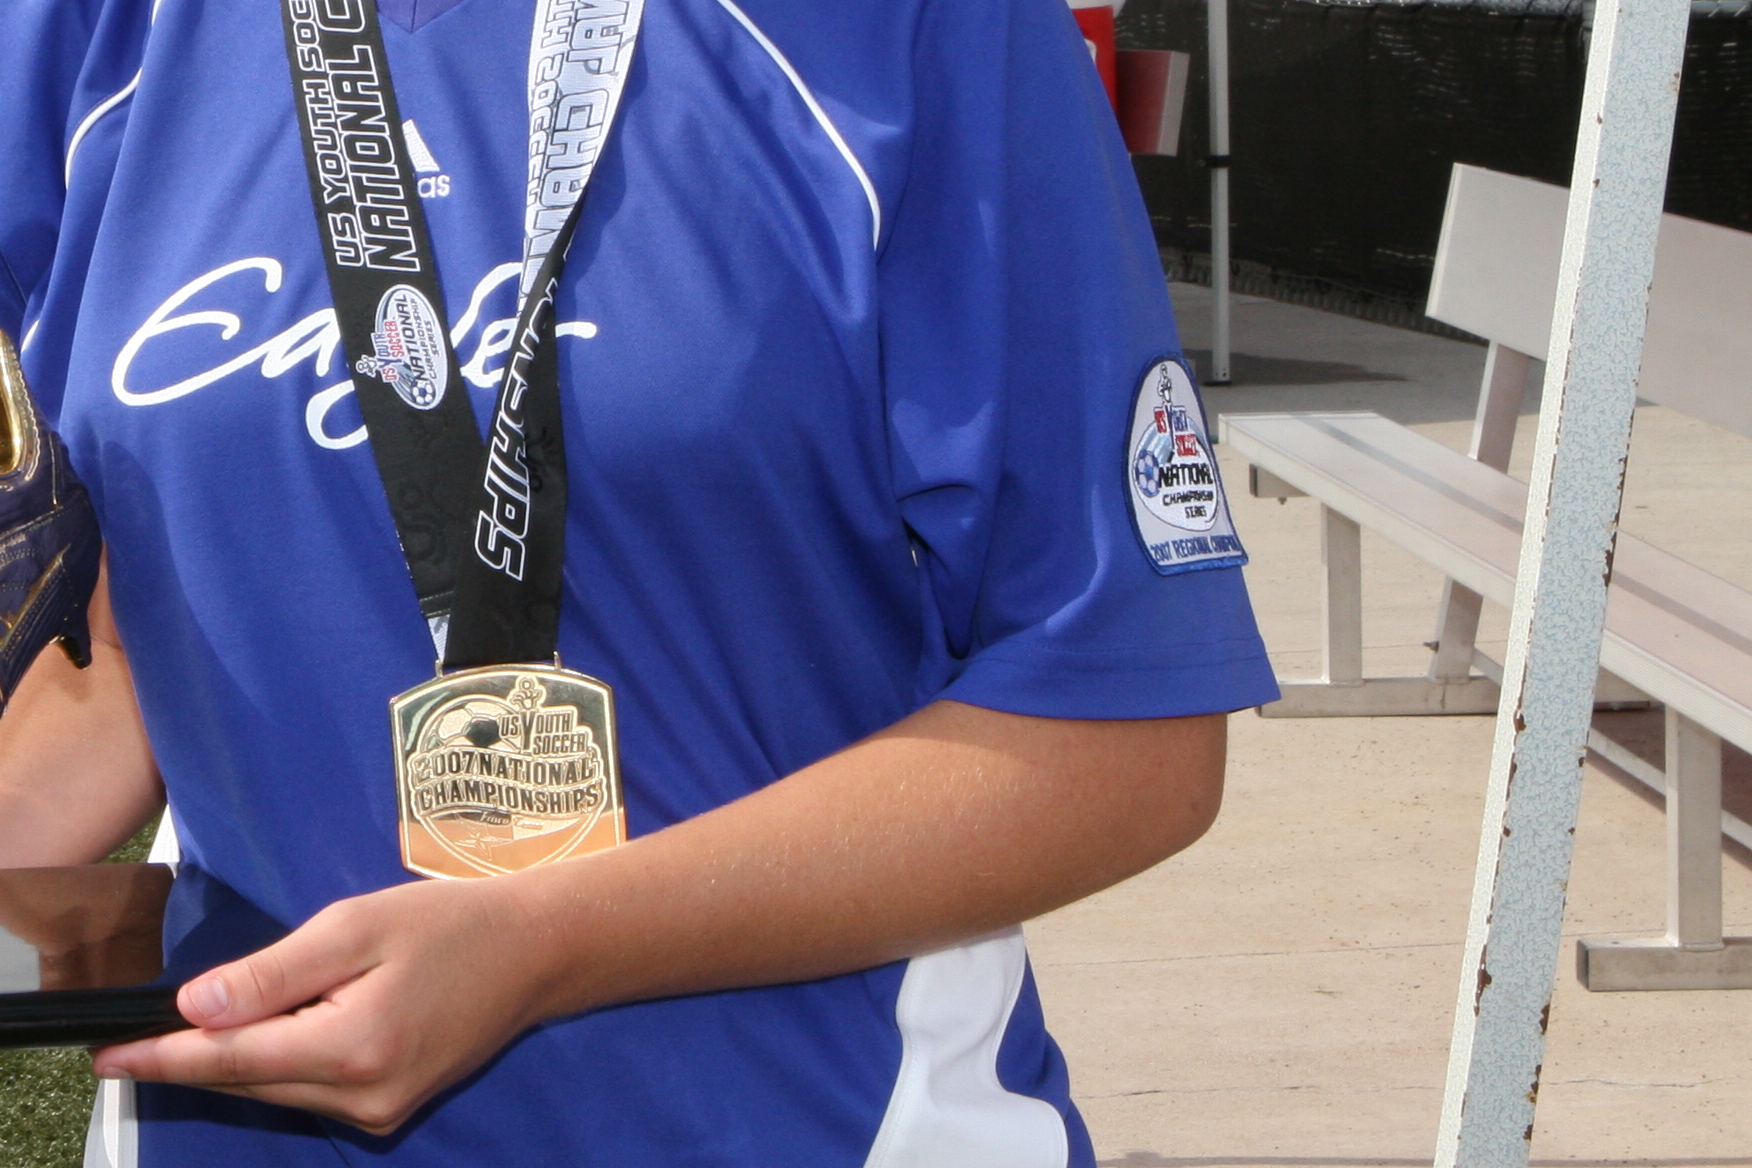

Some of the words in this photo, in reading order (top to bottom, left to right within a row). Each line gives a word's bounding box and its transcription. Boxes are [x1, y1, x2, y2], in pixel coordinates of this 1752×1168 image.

[303, 80, 351, 204] YOUTH
[326, 45, 421, 272] NATIONAL
[328, 213, 364, 267] US
[384, 320, 404, 358] SOCCER
[395, 294, 429, 381] NATIONAL
[410, 298, 437, 379] CHAMPIONSHIP
[424, 320, 439, 356] SERIES
[500, 716, 518, 737] US
[519, 710, 572, 750] YOUTH
[533, 733, 587, 755] SOCCER
[418, 751, 477, 778] 2007
[478, 752, 595, 786] NATIONAL
[420, 780, 600, 814] CHAMPIONSHIPS
